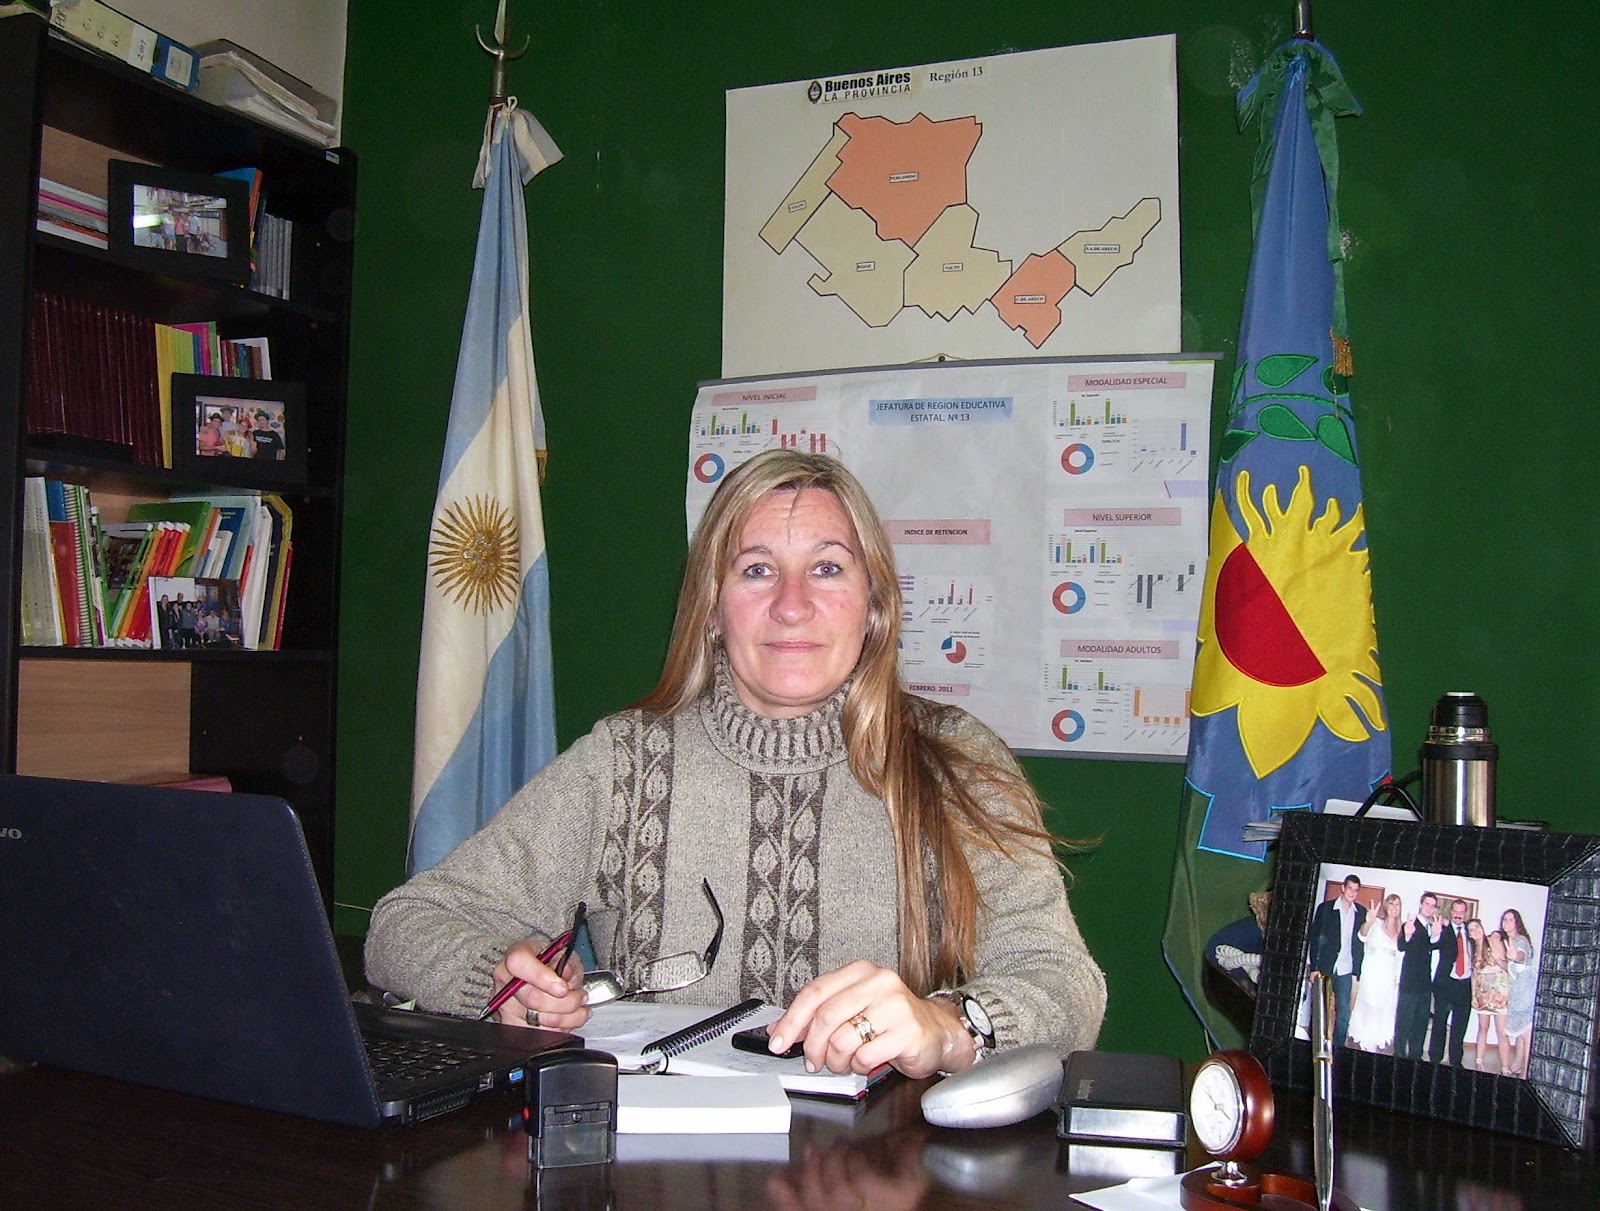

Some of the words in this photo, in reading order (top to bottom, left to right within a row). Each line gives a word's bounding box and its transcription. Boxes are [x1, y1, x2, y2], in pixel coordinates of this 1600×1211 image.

[929, 69, 968, 83] Región
[971, 66, 983, 77] 13
[825, 77, 874, 92] Buenos
[876, 72, 910, 85] Aires
[824, 91, 840, 102] LA
[844, 83, 911, 100] PROVINCIA
[1085, 377, 1132, 387] MODALIDAD
[1133, 376, 1168, 385] ESPECIAL
[741, 393, 761, 402] NIVEL
[762, 391, 787, 400] INICIAL
[876, 401, 914, 411] JEFATURA
[915, 401, 927, 410] DE
[928, 401, 959, 410] REGION
[961, 400, 1006, 409] EDUCATIVA
[961, 413, 970, 422] 13
[1092, 513, 1113, 522] NIVEL
[1115, 513, 1152, 522] SUPERIOR
[1077, 643, 1124, 654] MODALIDAD
[1125, 644, 1162, 654] ADULTOS
[938, 685, 953, 693] 2011
